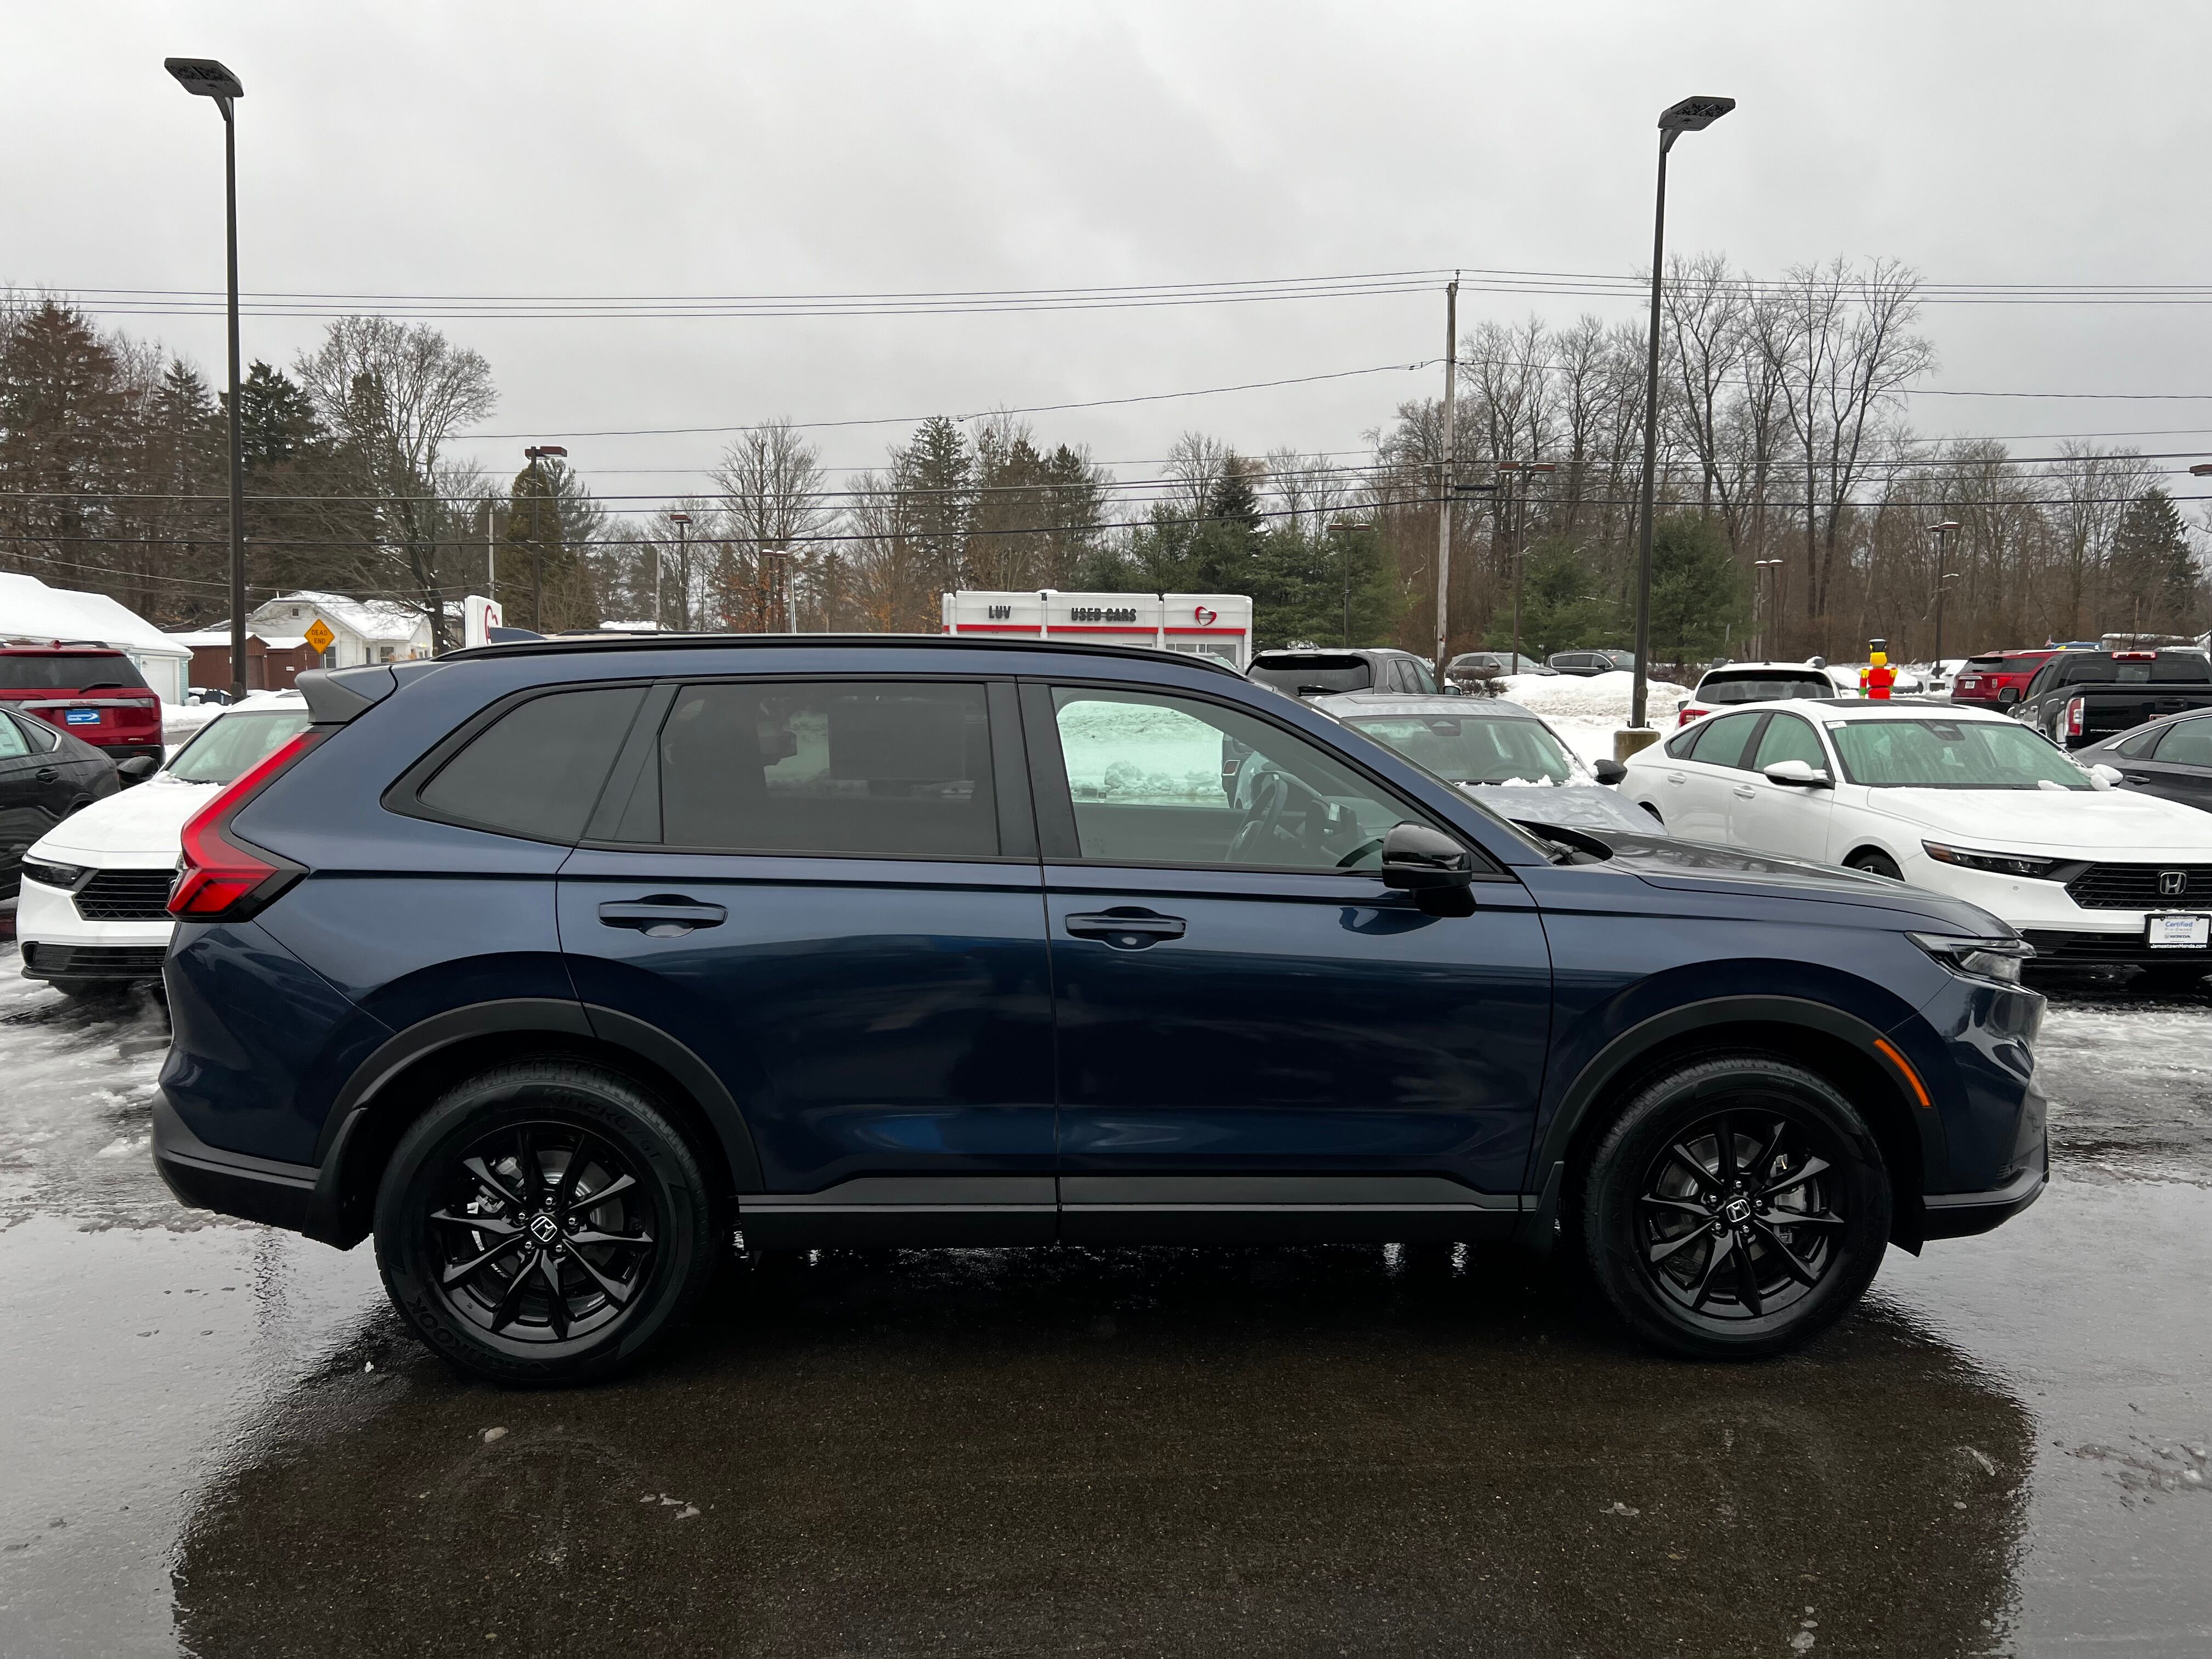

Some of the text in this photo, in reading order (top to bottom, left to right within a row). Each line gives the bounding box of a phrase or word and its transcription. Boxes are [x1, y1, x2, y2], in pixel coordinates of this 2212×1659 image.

[989, 606, 1011, 619] LUV
[1071, 607, 1137, 622] USED CARS
